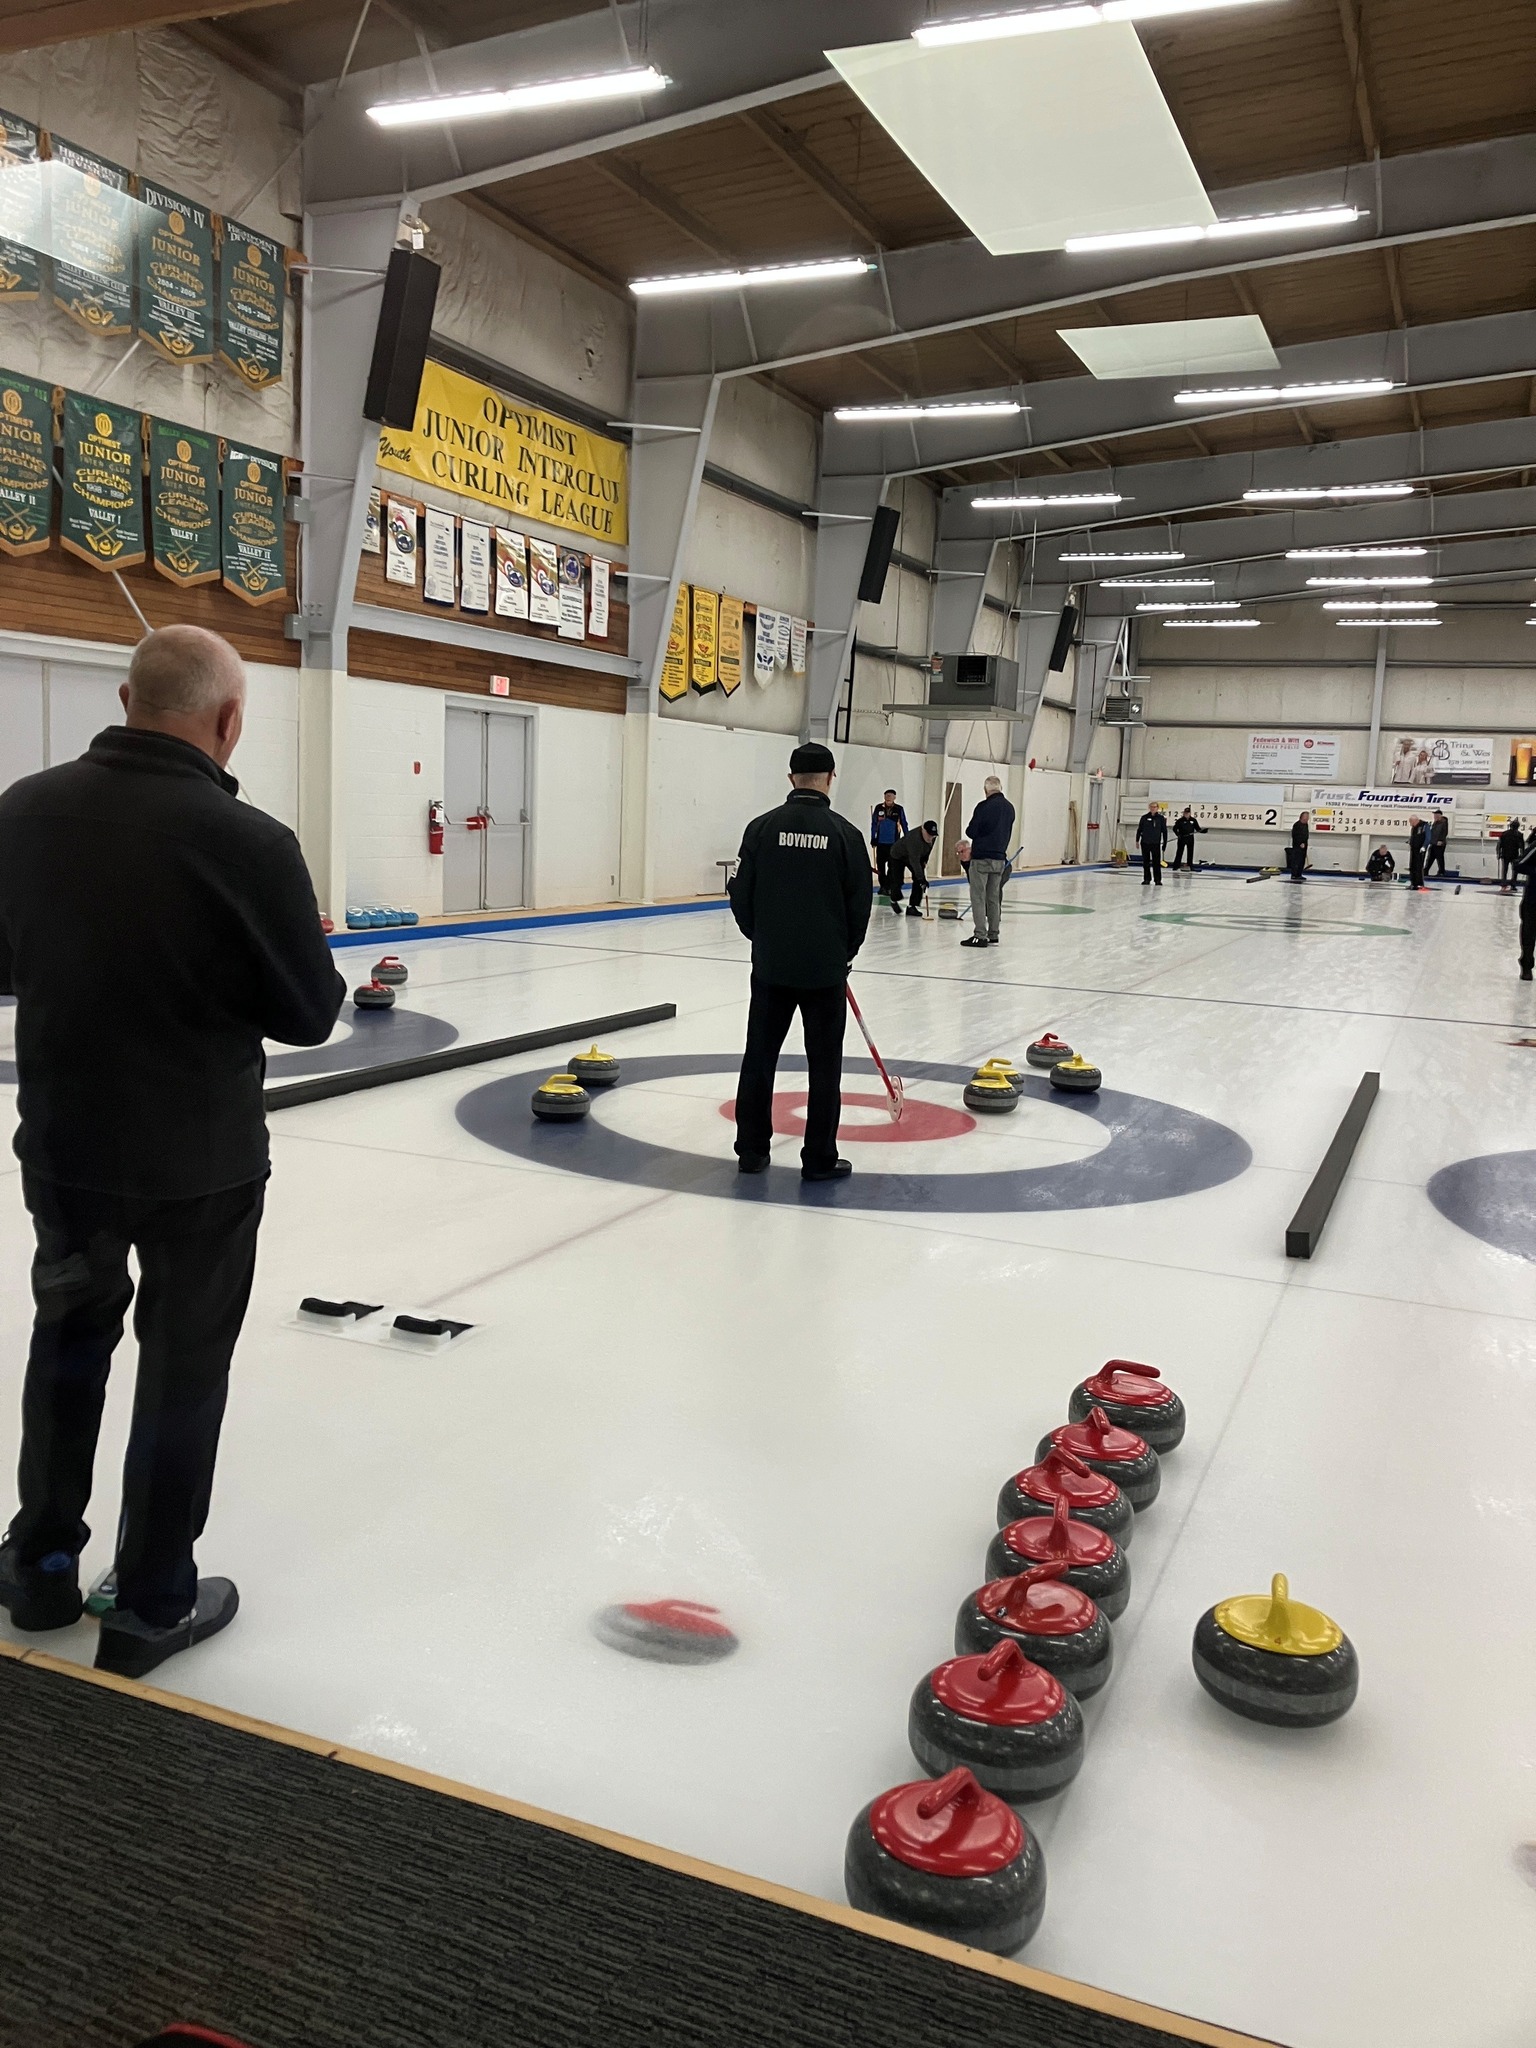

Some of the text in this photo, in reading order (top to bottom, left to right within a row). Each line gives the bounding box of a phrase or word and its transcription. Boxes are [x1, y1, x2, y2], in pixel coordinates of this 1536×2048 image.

[145, 187, 205, 229] DIVISION IV
[152, 236, 200, 267] JUNIOR
[233, 266, 275, 294] JUNIOR
[158, 299, 186, 316] VALLEY
[0, 421, 42, 445] NIOR
[88, 433, 122, 449] OPTIMIST
[422, 408, 505, 464] JUNIOR
[79, 440, 132, 467] JUNIOR
[379, 436, 412, 462] Youth
[76, 468, 132, 491] CURLING
[79, 475, 129, 496] LEAGUE
[160, 465, 206, 489] JUNIOR
[0, 488, 26, 503] ALLEY
[73, 482, 134, 509] CHAMPIONS
[158, 492, 209, 512] CURLING
[234, 487, 273, 507] JUNIOR
[432, 450, 614, 534] CURLING LEAGUE
[88, 507, 116, 523] VALLEY
[155, 506, 212, 530] CHAMPIONS
[170, 527, 194, 541] VALLEY
[238, 545, 263, 558] VALLEY
[1358, 790, 1423, 803] Fountain
[1425, 793, 1453, 805] Tire
[1264, 809, 1277, 826] 2
[778, 831, 829, 850] BOYNTON
